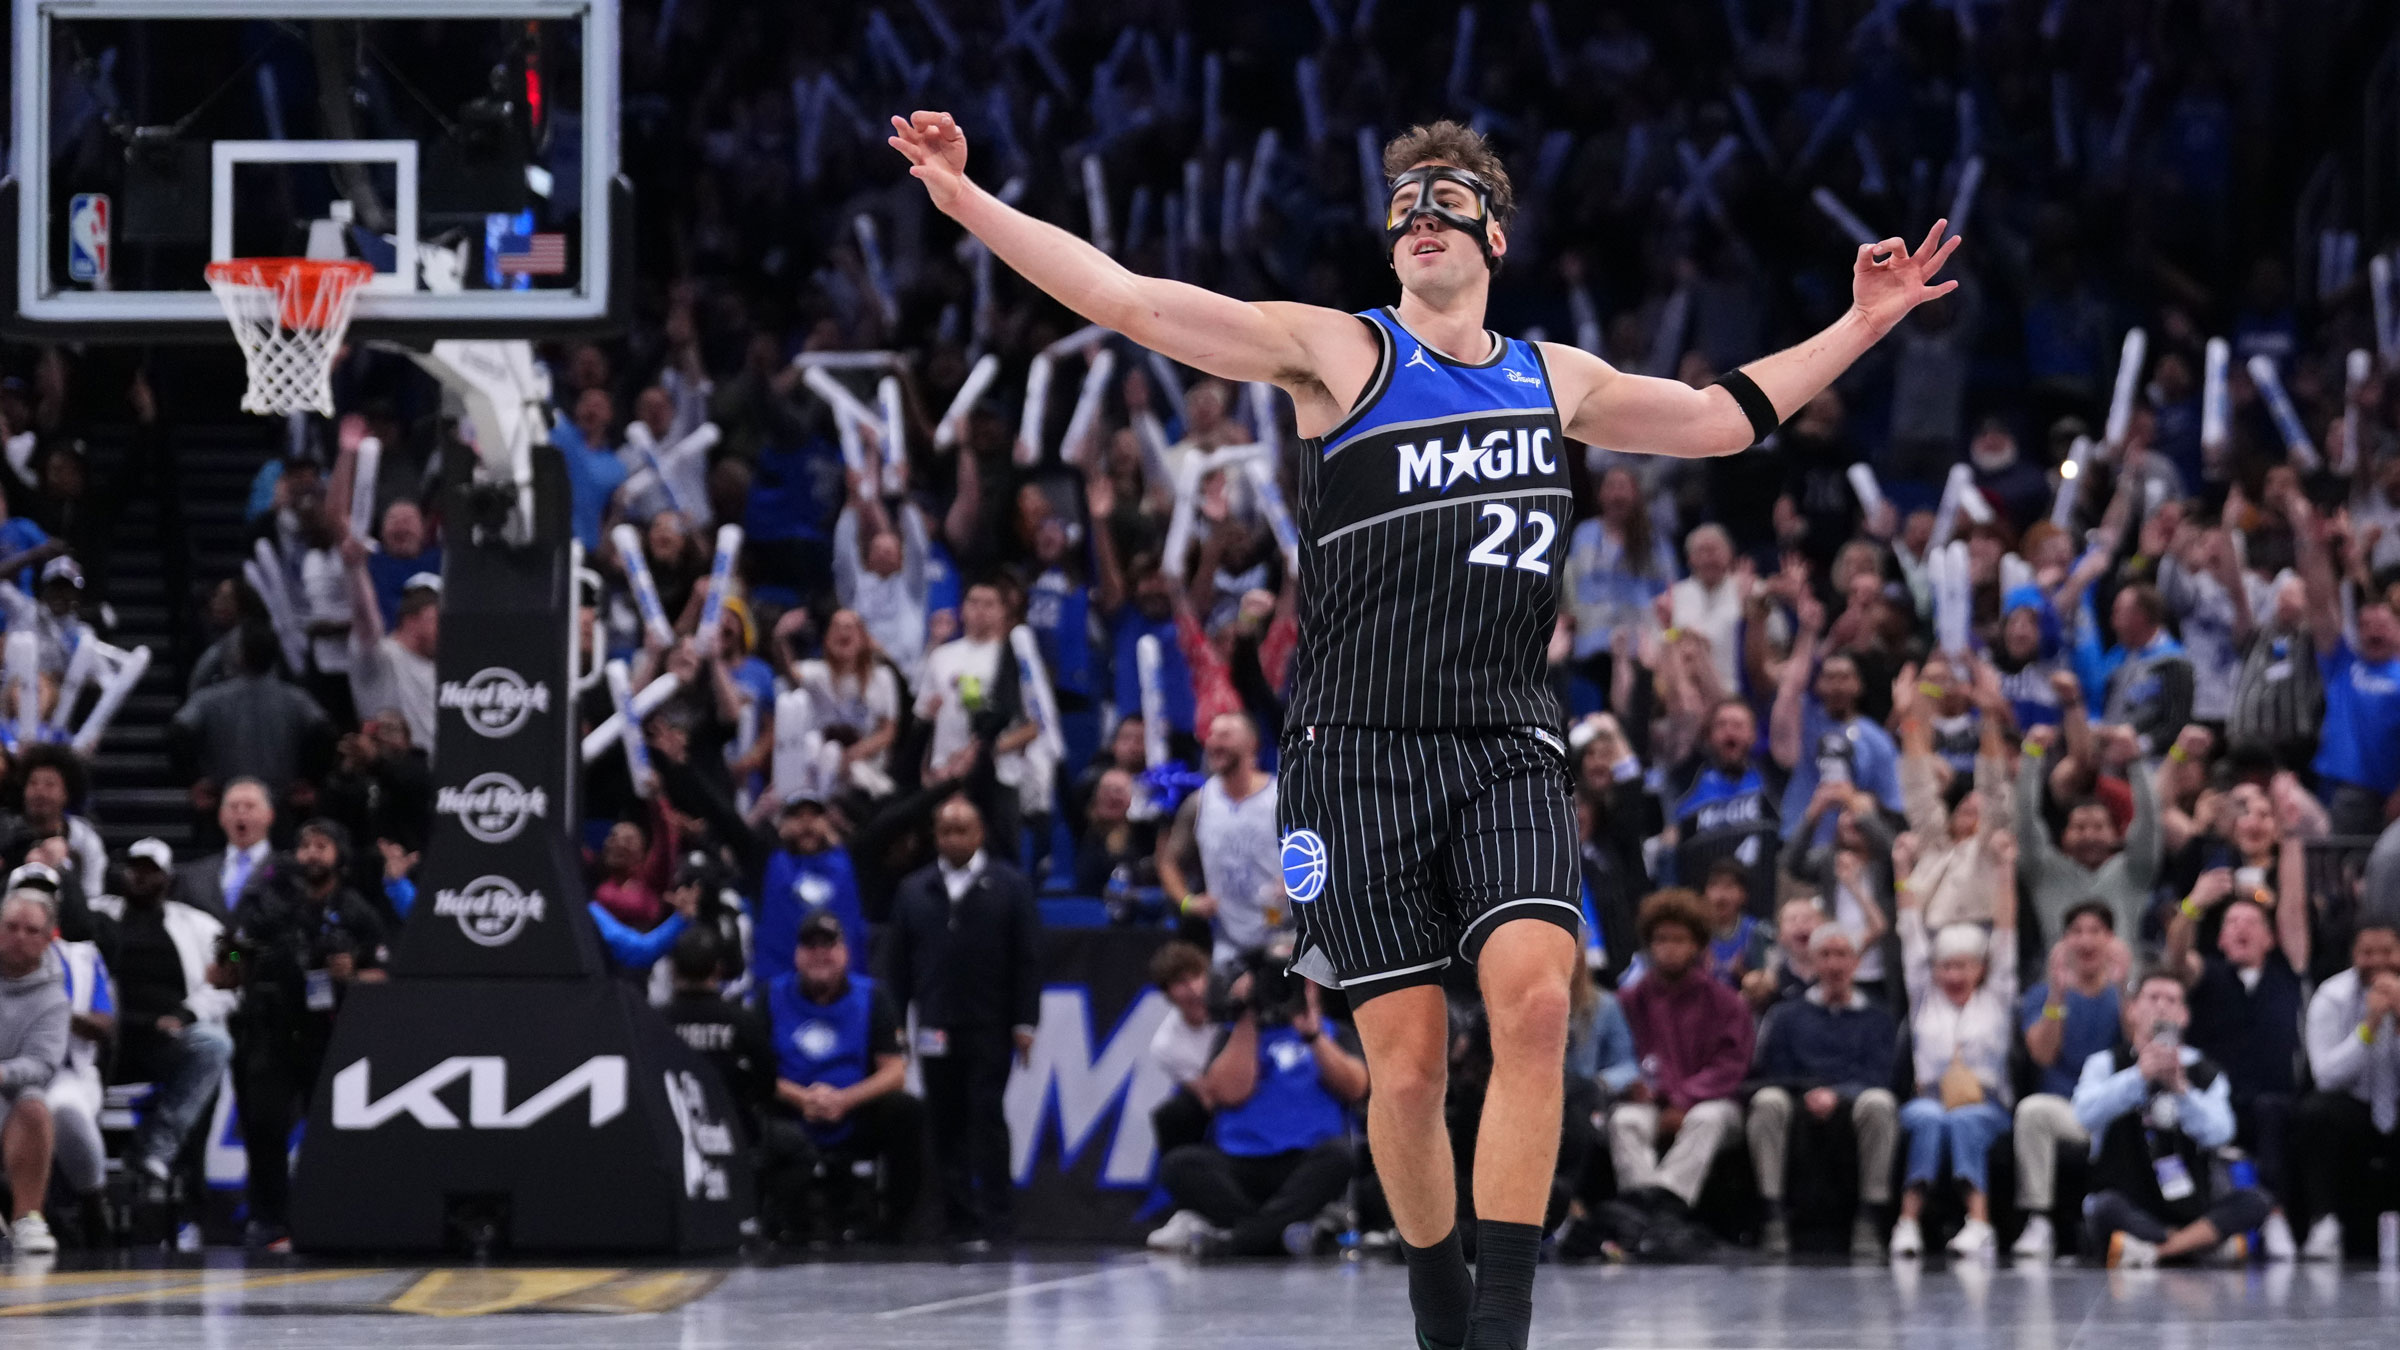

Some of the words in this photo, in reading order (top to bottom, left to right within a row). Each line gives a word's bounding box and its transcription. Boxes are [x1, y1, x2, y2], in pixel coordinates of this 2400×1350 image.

[1502, 367, 1541, 389] Disney
[1466, 502, 1557, 575] 22
[439, 680, 497, 708] Hard
[496, 681, 549, 713] Rock
[436, 785, 494, 813] Hard
[493, 786, 546, 818] Rock
[434, 888, 492, 916] Hard
[490, 889, 543, 922] Rock
[331, 1054, 628, 1130] KIA
